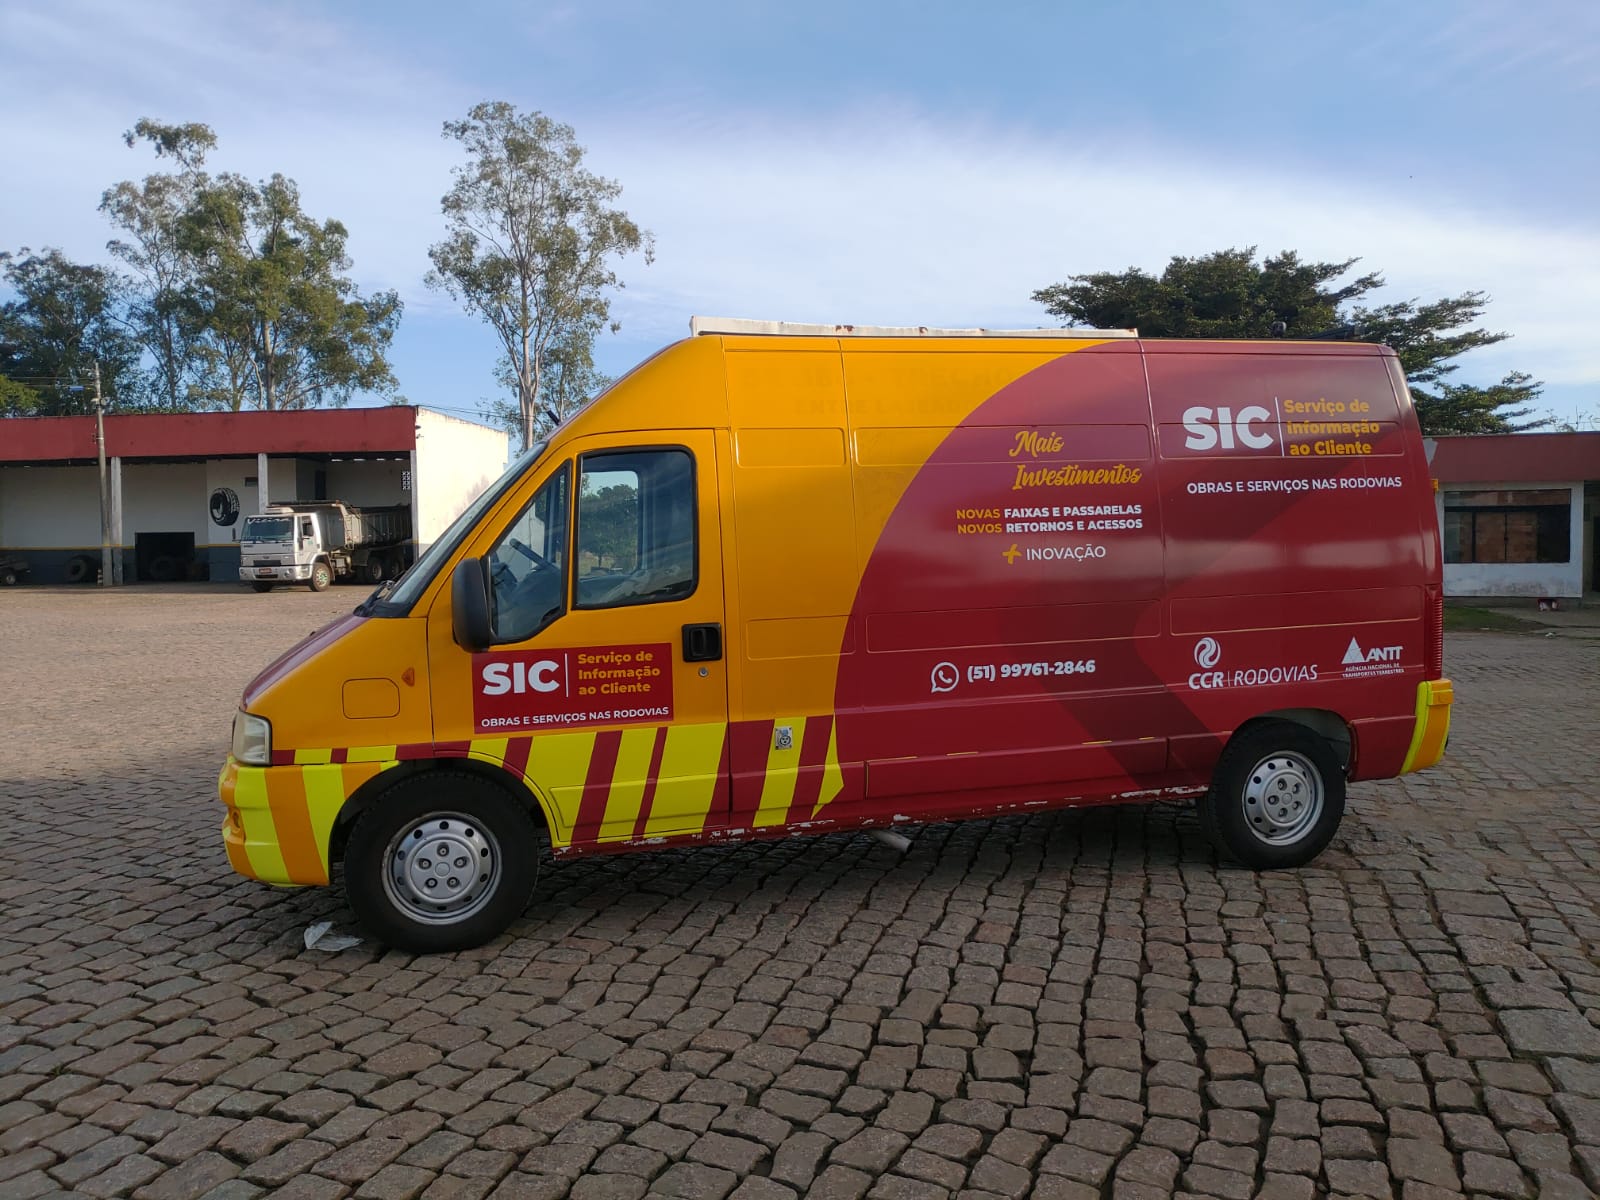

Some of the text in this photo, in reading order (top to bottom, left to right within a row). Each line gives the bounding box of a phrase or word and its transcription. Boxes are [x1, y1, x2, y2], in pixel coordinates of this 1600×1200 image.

[1284, 398, 1369, 417] Serviço de
[1182, 405, 1274, 451] SIC
[1009, 431, 1064, 457] Mais
[1290, 440, 1373, 456] ao Cliente
[1012, 464, 1142, 490] Investimentos
[1186, 477, 1402, 494] OBRAS E SERVIÇOS NAS RODOVIAS
[956, 505, 1142, 519] NOVAS FAIXAS E PASSARELAS
[957, 519, 1143, 534] NOVOS RETORNOS E ACESSOS
[1026, 544, 1106, 562] INOVAÇÃO
[578, 651, 653, 665] Serviço de
[1364, 646, 1403, 662] ANTT
[482, 660, 560, 695] SIC
[578, 666, 660, 681] Informação
[967, 660, 1096, 683] (51) 99761-2846
[1188, 664, 1318, 690] CCR RODOVIAS
[579, 682, 651, 696] ao Cliente
[481, 707, 669, 728] OBRAS E SERVIÇOS NAS RODOVIAS
